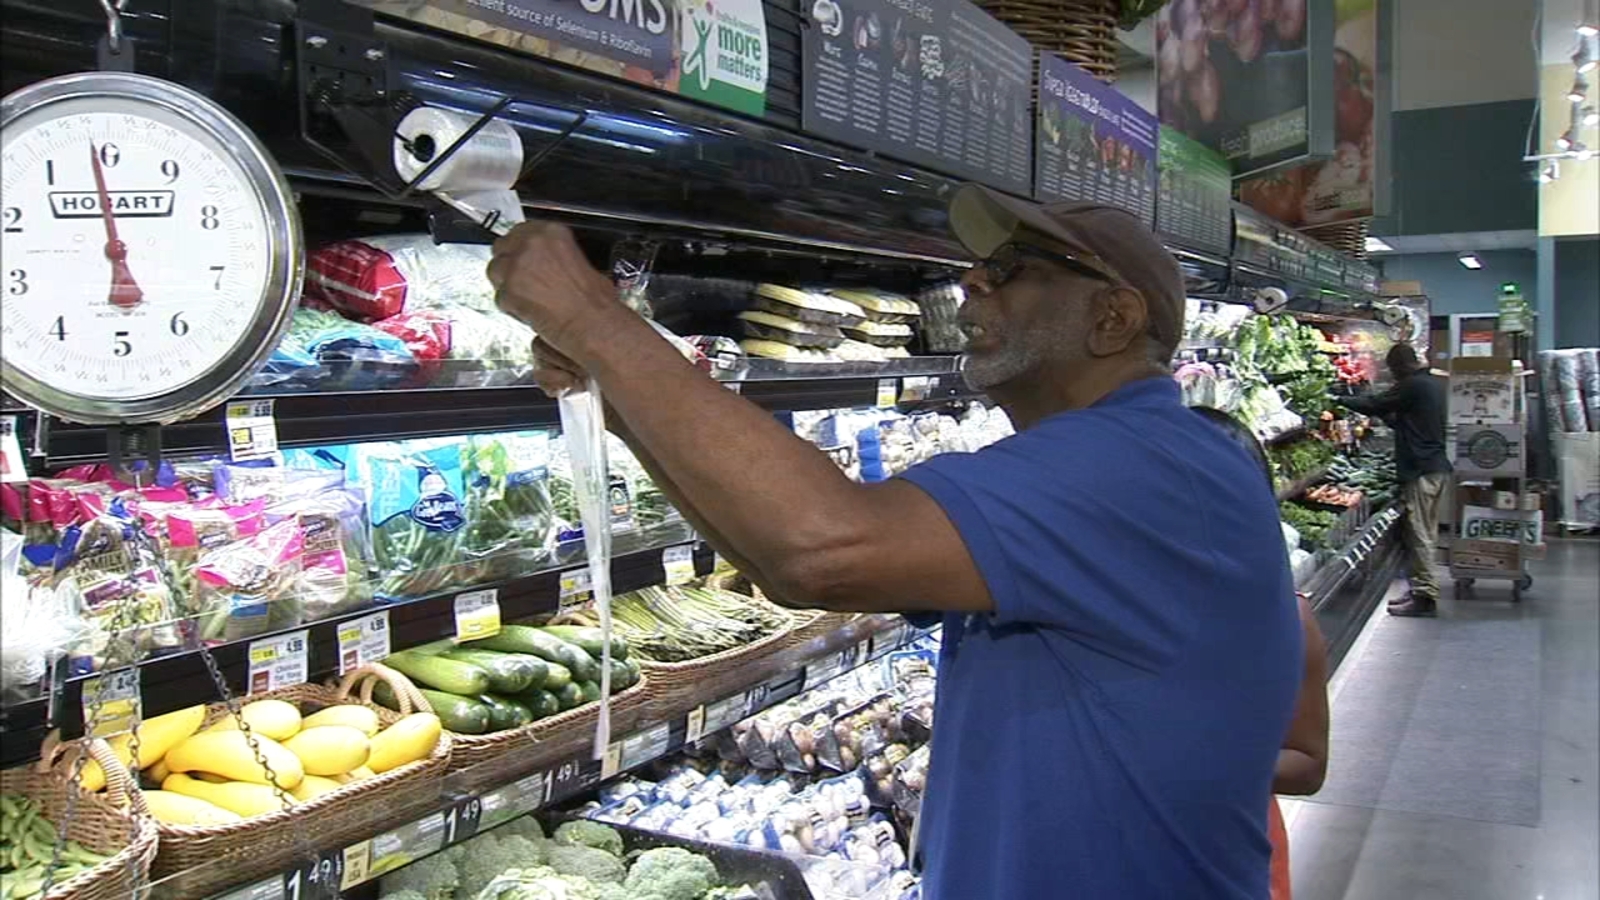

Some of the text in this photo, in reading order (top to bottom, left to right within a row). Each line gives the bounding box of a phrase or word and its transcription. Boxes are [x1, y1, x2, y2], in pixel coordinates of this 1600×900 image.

[507, 4, 542, 24] source
[543, 14, 555, 26] of
[556, 16, 600, 41] Selenium
[600, 31, 608, 44] &
[580, 0, 666, 34] MS
[718, 25, 761, 61] more
[718, 54, 761, 81] matters
[46, 160, 54, 185] 1
[161, 160, 180, 184] 9
[4, 207, 23, 233] 2
[201, 205, 220, 230] 8
[9, 269, 29, 295] 3
[209, 266, 225, 290] 7
[49, 315, 68, 341] 4
[170, 311, 189, 336] 6
[113, 331, 132, 357] 5
[544, 764, 572, 802] 1 49
[447, 807, 458, 843] 1
[462, 800, 479, 821] 49
[288, 859, 331, 900] 1 49
